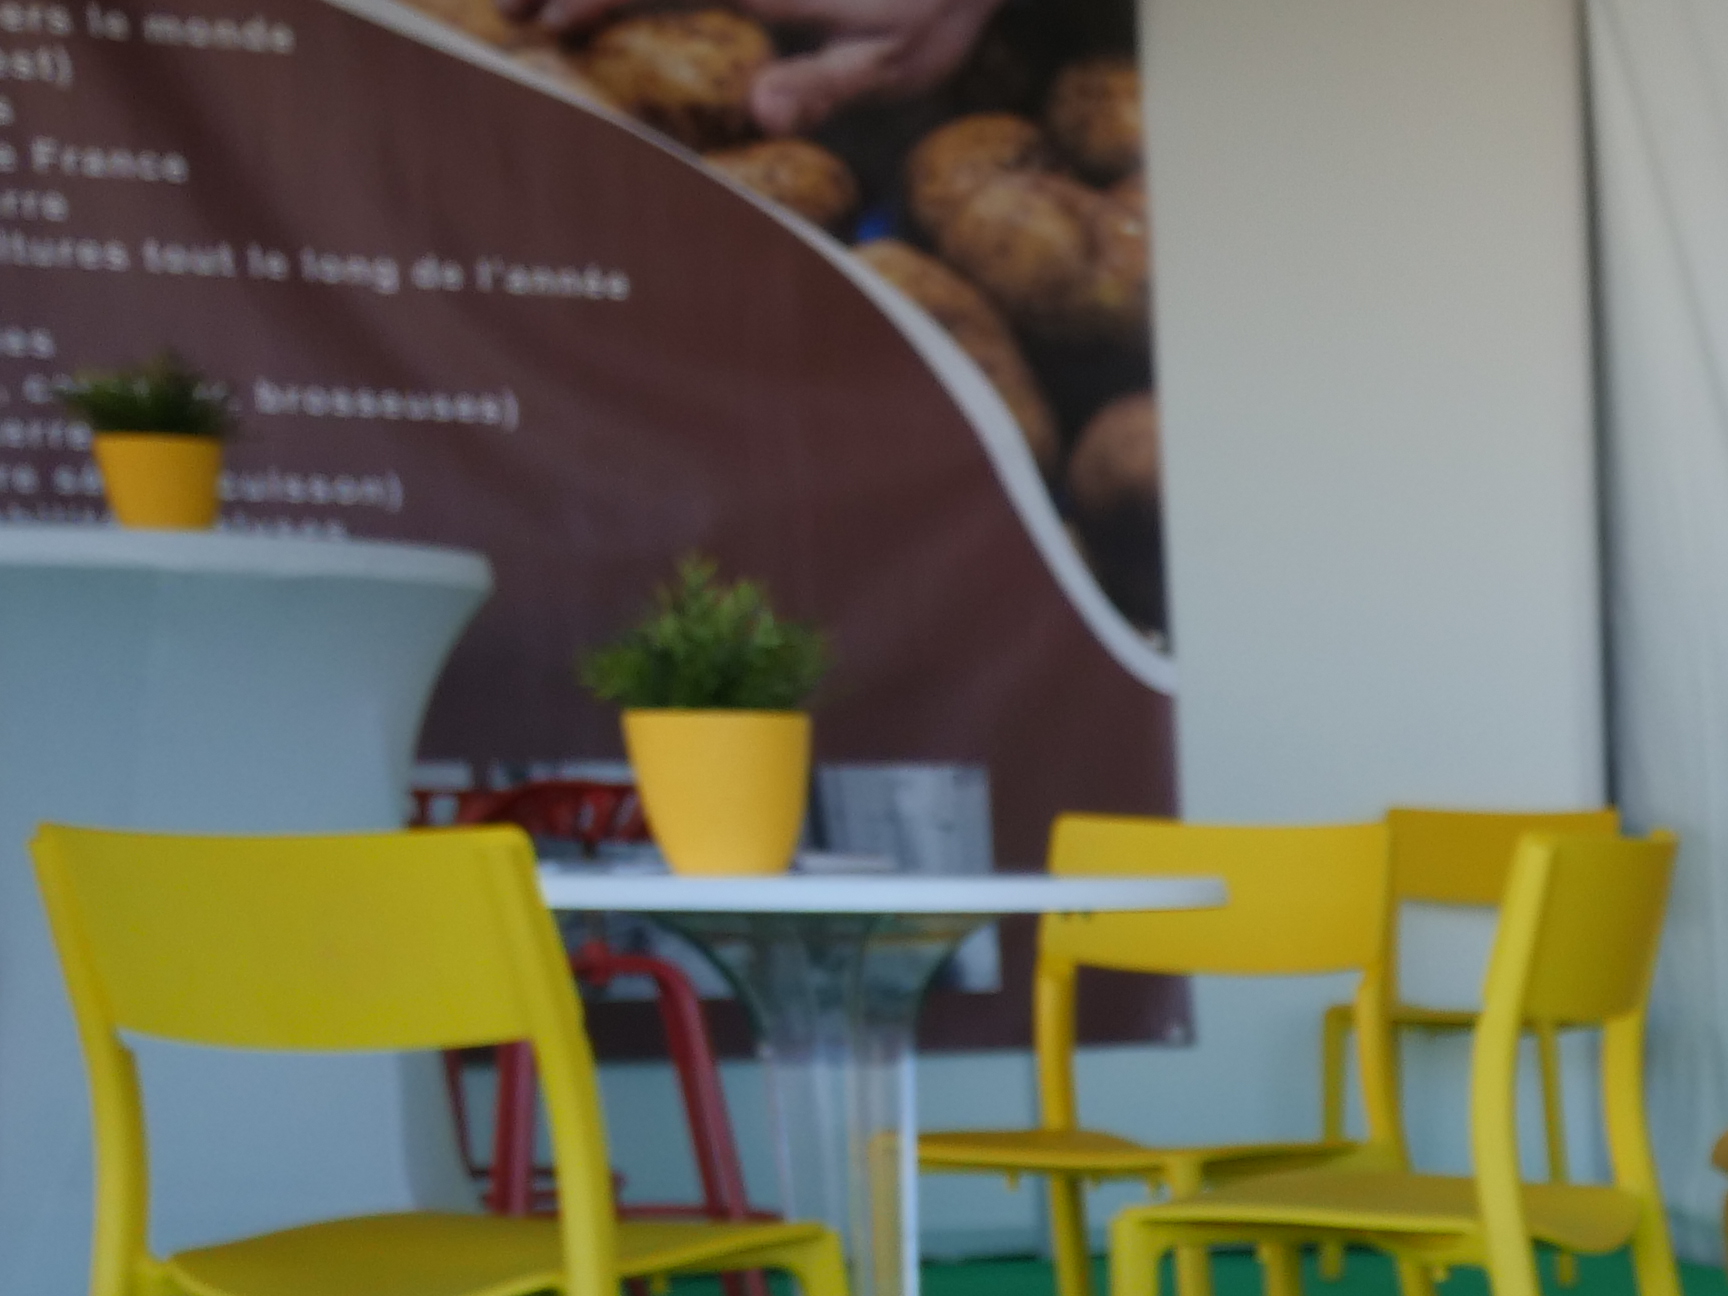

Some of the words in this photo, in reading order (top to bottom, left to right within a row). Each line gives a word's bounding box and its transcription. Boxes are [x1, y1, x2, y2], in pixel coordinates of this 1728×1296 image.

[143, 12, 296, 54] monde
[30, 136, 191, 183] France
[142, 236, 237, 278] tout
[247, 241, 290, 281] le
[302, 246, 399, 295] long
[410, 252, 465, 292] de
